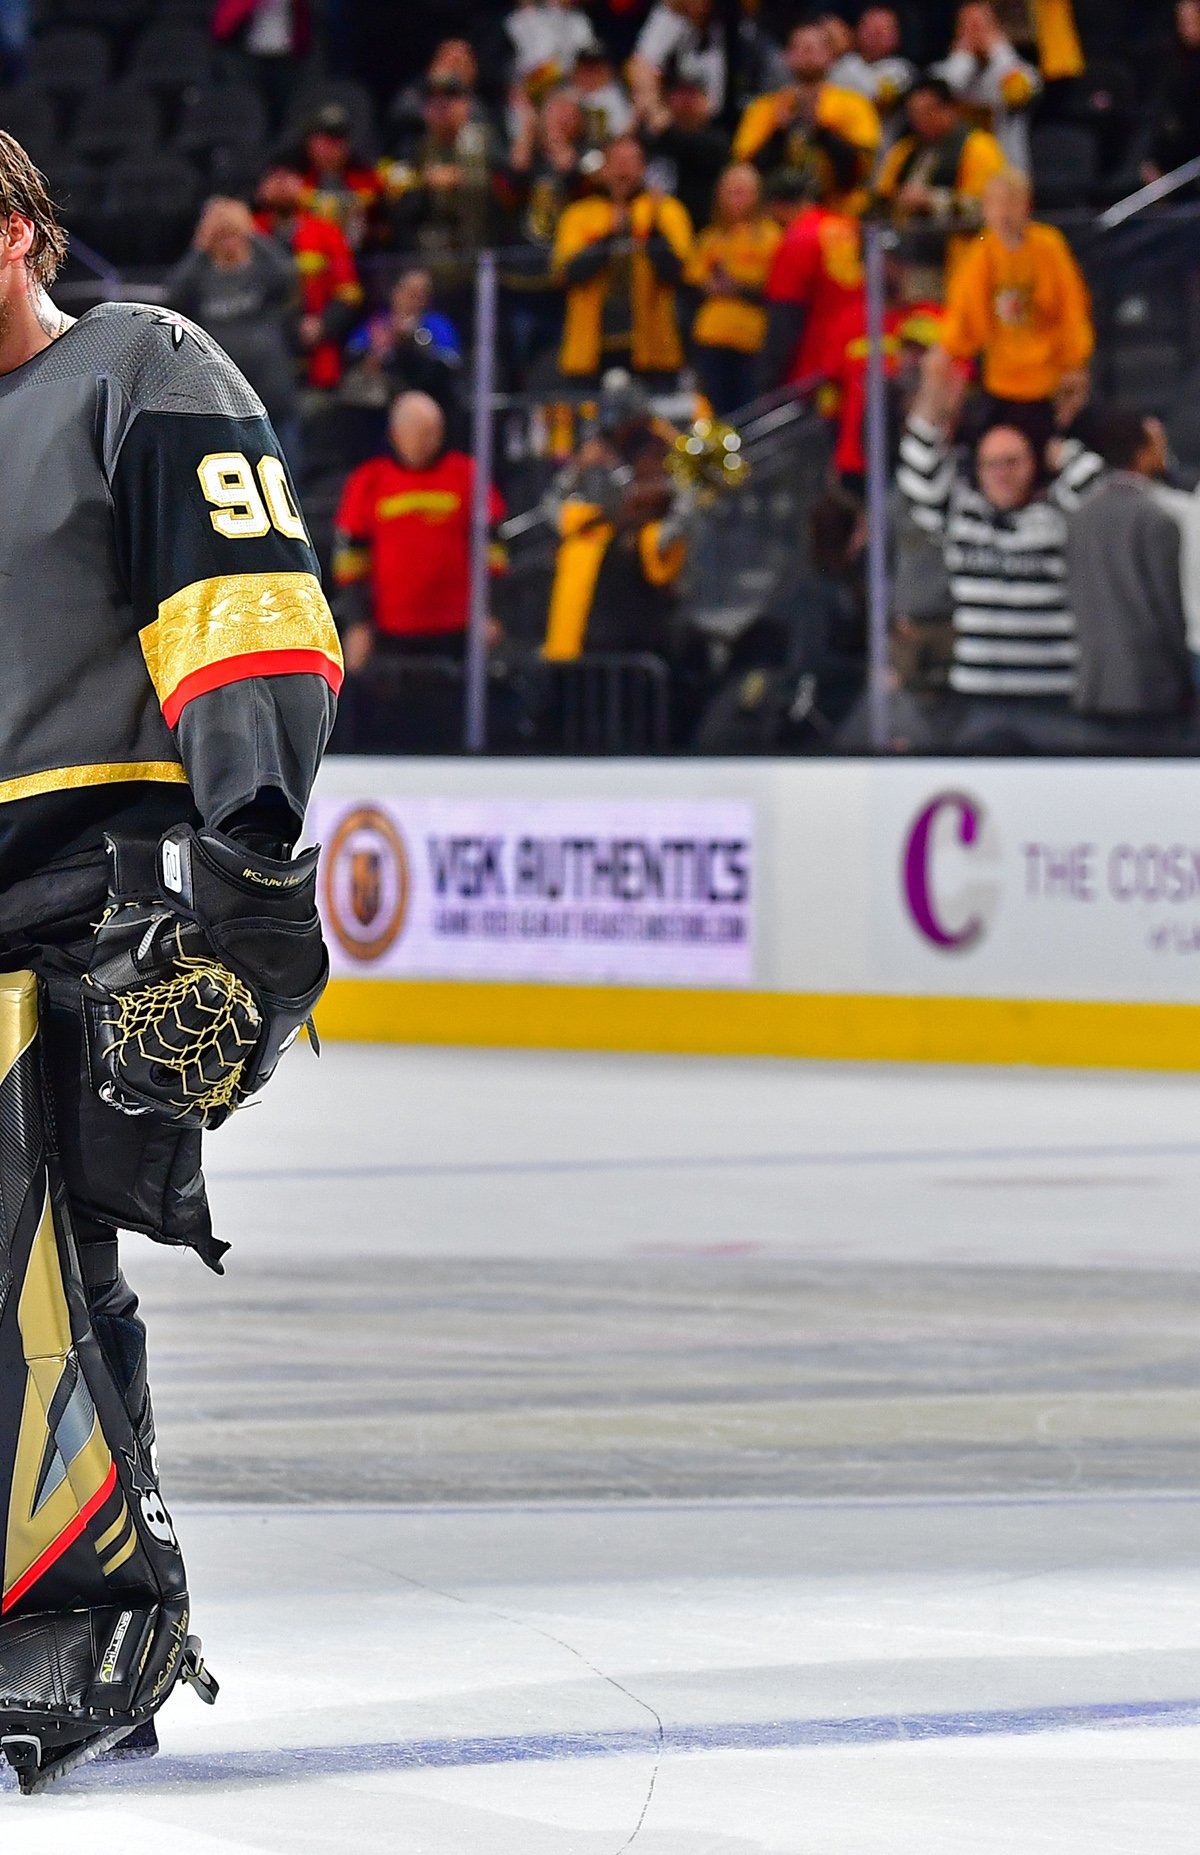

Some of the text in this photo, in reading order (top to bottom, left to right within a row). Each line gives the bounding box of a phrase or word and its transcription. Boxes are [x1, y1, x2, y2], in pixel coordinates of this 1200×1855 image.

[197, 452, 310, 548] 90
[514, 838, 747, 904] AUTHENTICS
[1021, 842, 1097, 901] THE
